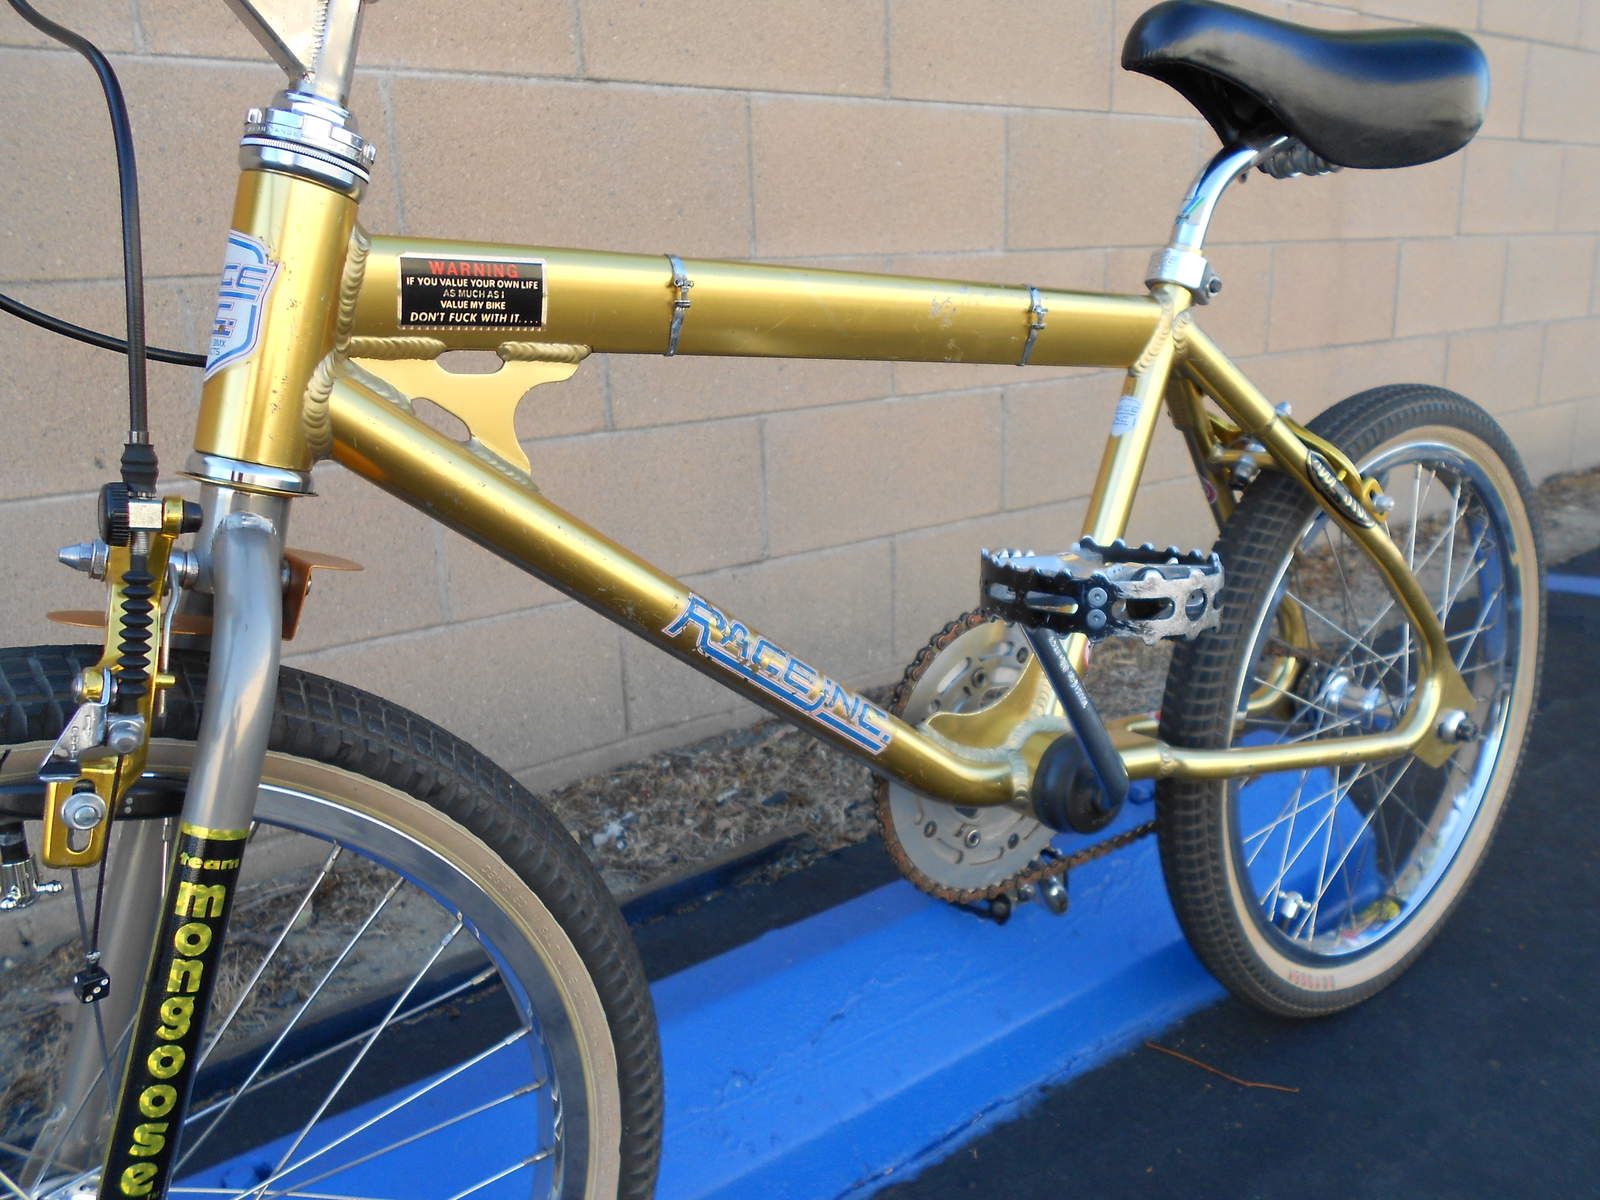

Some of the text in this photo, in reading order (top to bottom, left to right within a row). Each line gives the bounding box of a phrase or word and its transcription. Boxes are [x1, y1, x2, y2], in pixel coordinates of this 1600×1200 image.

[429, 261, 520, 277] WARNING
[406, 277, 539, 290] IF YOU VALUE YOUR OWN LIFE
[443, 289, 456, 298] AS
[458, 289, 485, 298] MUCH
[487, 290, 500, 299] AS
[440, 300, 506, 310] VALUE MY BIKE
[410, 312, 446, 322] DON'T
[449, 312, 479, 323] FUCK
[481, 313, 508, 323] WITH
[179, 851, 240, 870] team
[120, 881, 226, 1198] mongoose
